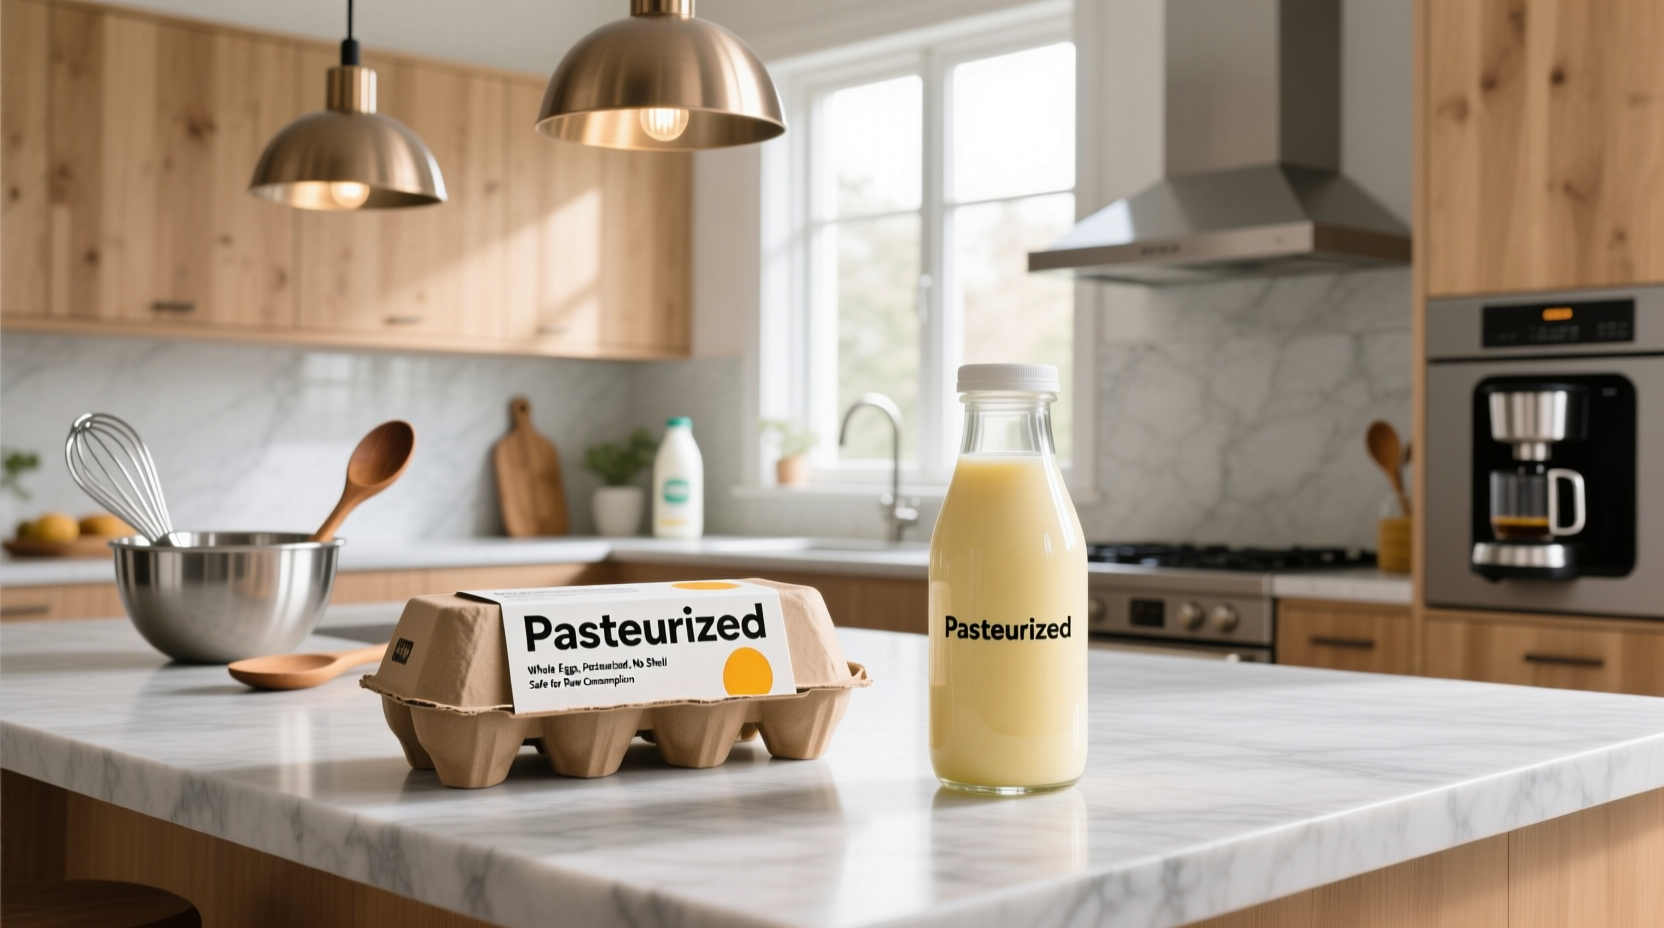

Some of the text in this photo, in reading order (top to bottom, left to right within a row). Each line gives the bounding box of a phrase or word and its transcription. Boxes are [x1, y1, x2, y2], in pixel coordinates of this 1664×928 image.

[523, 602, 767, 652] Pasteurized
[945, 615, 1071, 640] Pasteurized
[646, 656, 668, 668] Shell
[529, 679, 549, 690] Safe
